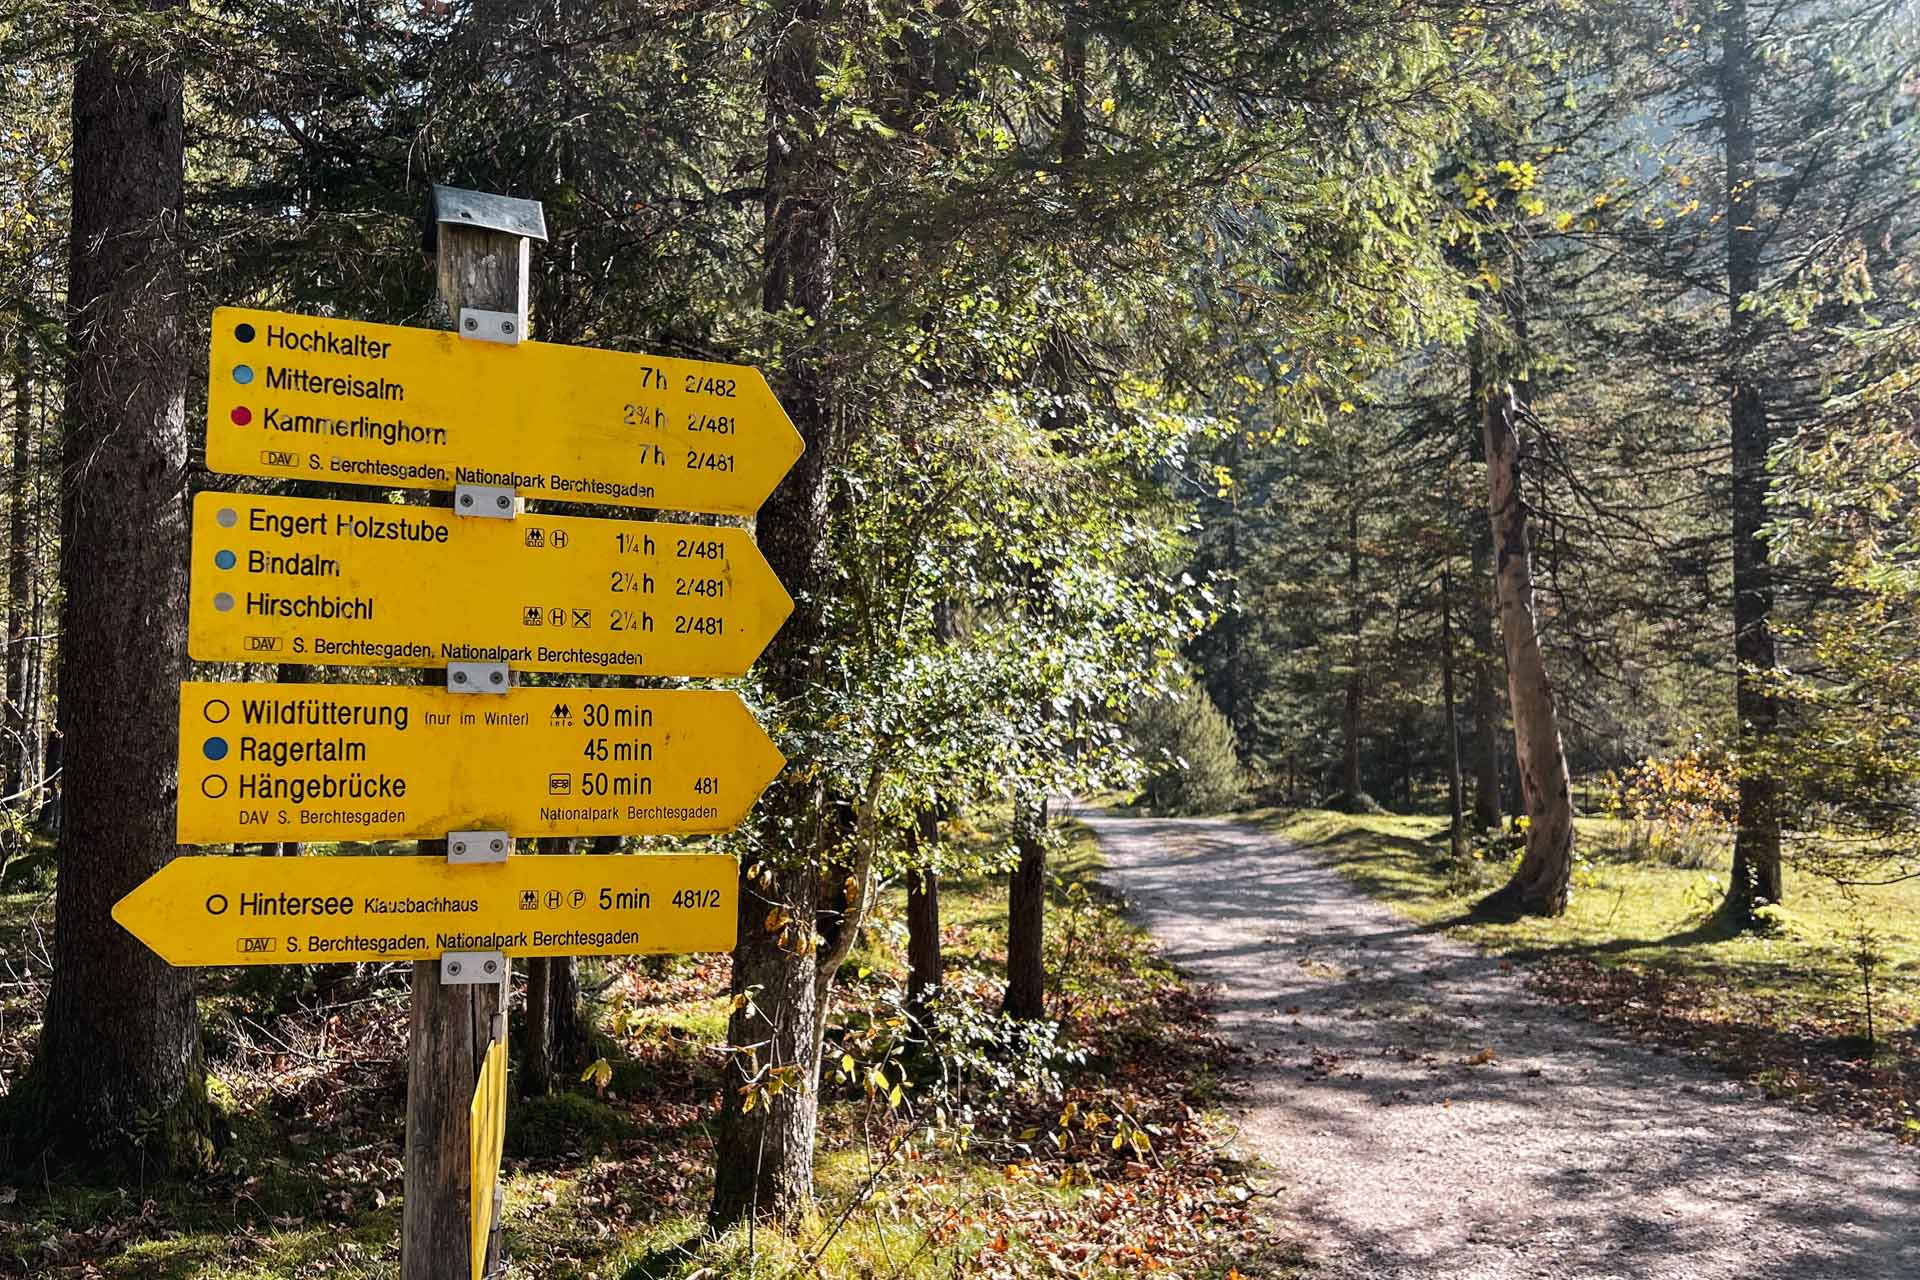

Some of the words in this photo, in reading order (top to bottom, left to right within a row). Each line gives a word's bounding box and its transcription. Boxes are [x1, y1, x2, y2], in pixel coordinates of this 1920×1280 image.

[267, 325, 391, 359] Hochkalter
[266, 366, 404, 401] Mittereisalm
[686, 375, 736, 397] 2/482
[264, 408, 447, 445] Kammerlinghorn
[688, 415, 734, 435] 2/481
[687, 451, 733, 472] 2/481
[268, 452, 292, 466] DAV
[309, 454, 323, 470] S.
[455, 467, 545, 489] Nationalpark
[551, 475, 654, 498] Berchtesgaden
[250, 508, 327, 537] Engert
[337, 514, 448, 543] Holzstube
[677, 540, 724, 560] 2/481
[248, 550, 339, 577] Bindalm
[676, 578, 723, 597] 2/481
[247, 592, 372, 620] Hirschbichl
[676, 616, 722, 635] 2/481
[252, 638, 276, 650] DAV
[293, 637, 308, 653] S.
[441, 643, 532, 663] Nationalpark
[538, 647, 642, 666] Berchtesgaden
[242, 700, 408, 731] Wildfütterung
[461, 712, 475, 725] im
[584, 704, 609, 727] 30
[615, 705, 652, 727] min
[241, 737, 366, 767] Ragertalm
[584, 738, 608, 761] 45
[614, 739, 652, 761] min
[240, 773, 406, 804] Hängebrücke
[582, 773, 608, 796] 50
[614, 773, 651, 795] min
[694, 777, 717, 794] 481
[240, 811, 269, 824] DAV
[278, 810, 290, 824] S.
[301, 810, 405, 826] Berchtesgaden
[541, 807, 619, 824] Nationalpark
[628, 806, 717, 821] Berchtesgaden
[240, 892, 354, 915] Hintersee
[616, 888, 650, 909] min
[672, 890, 720, 908] 481/2
[244, 938, 269, 951] DAV
[287, 936, 301, 952] S.
[436, 932, 527, 950] Nationalpark
[533, 929, 639, 947] Berchtesgaden
